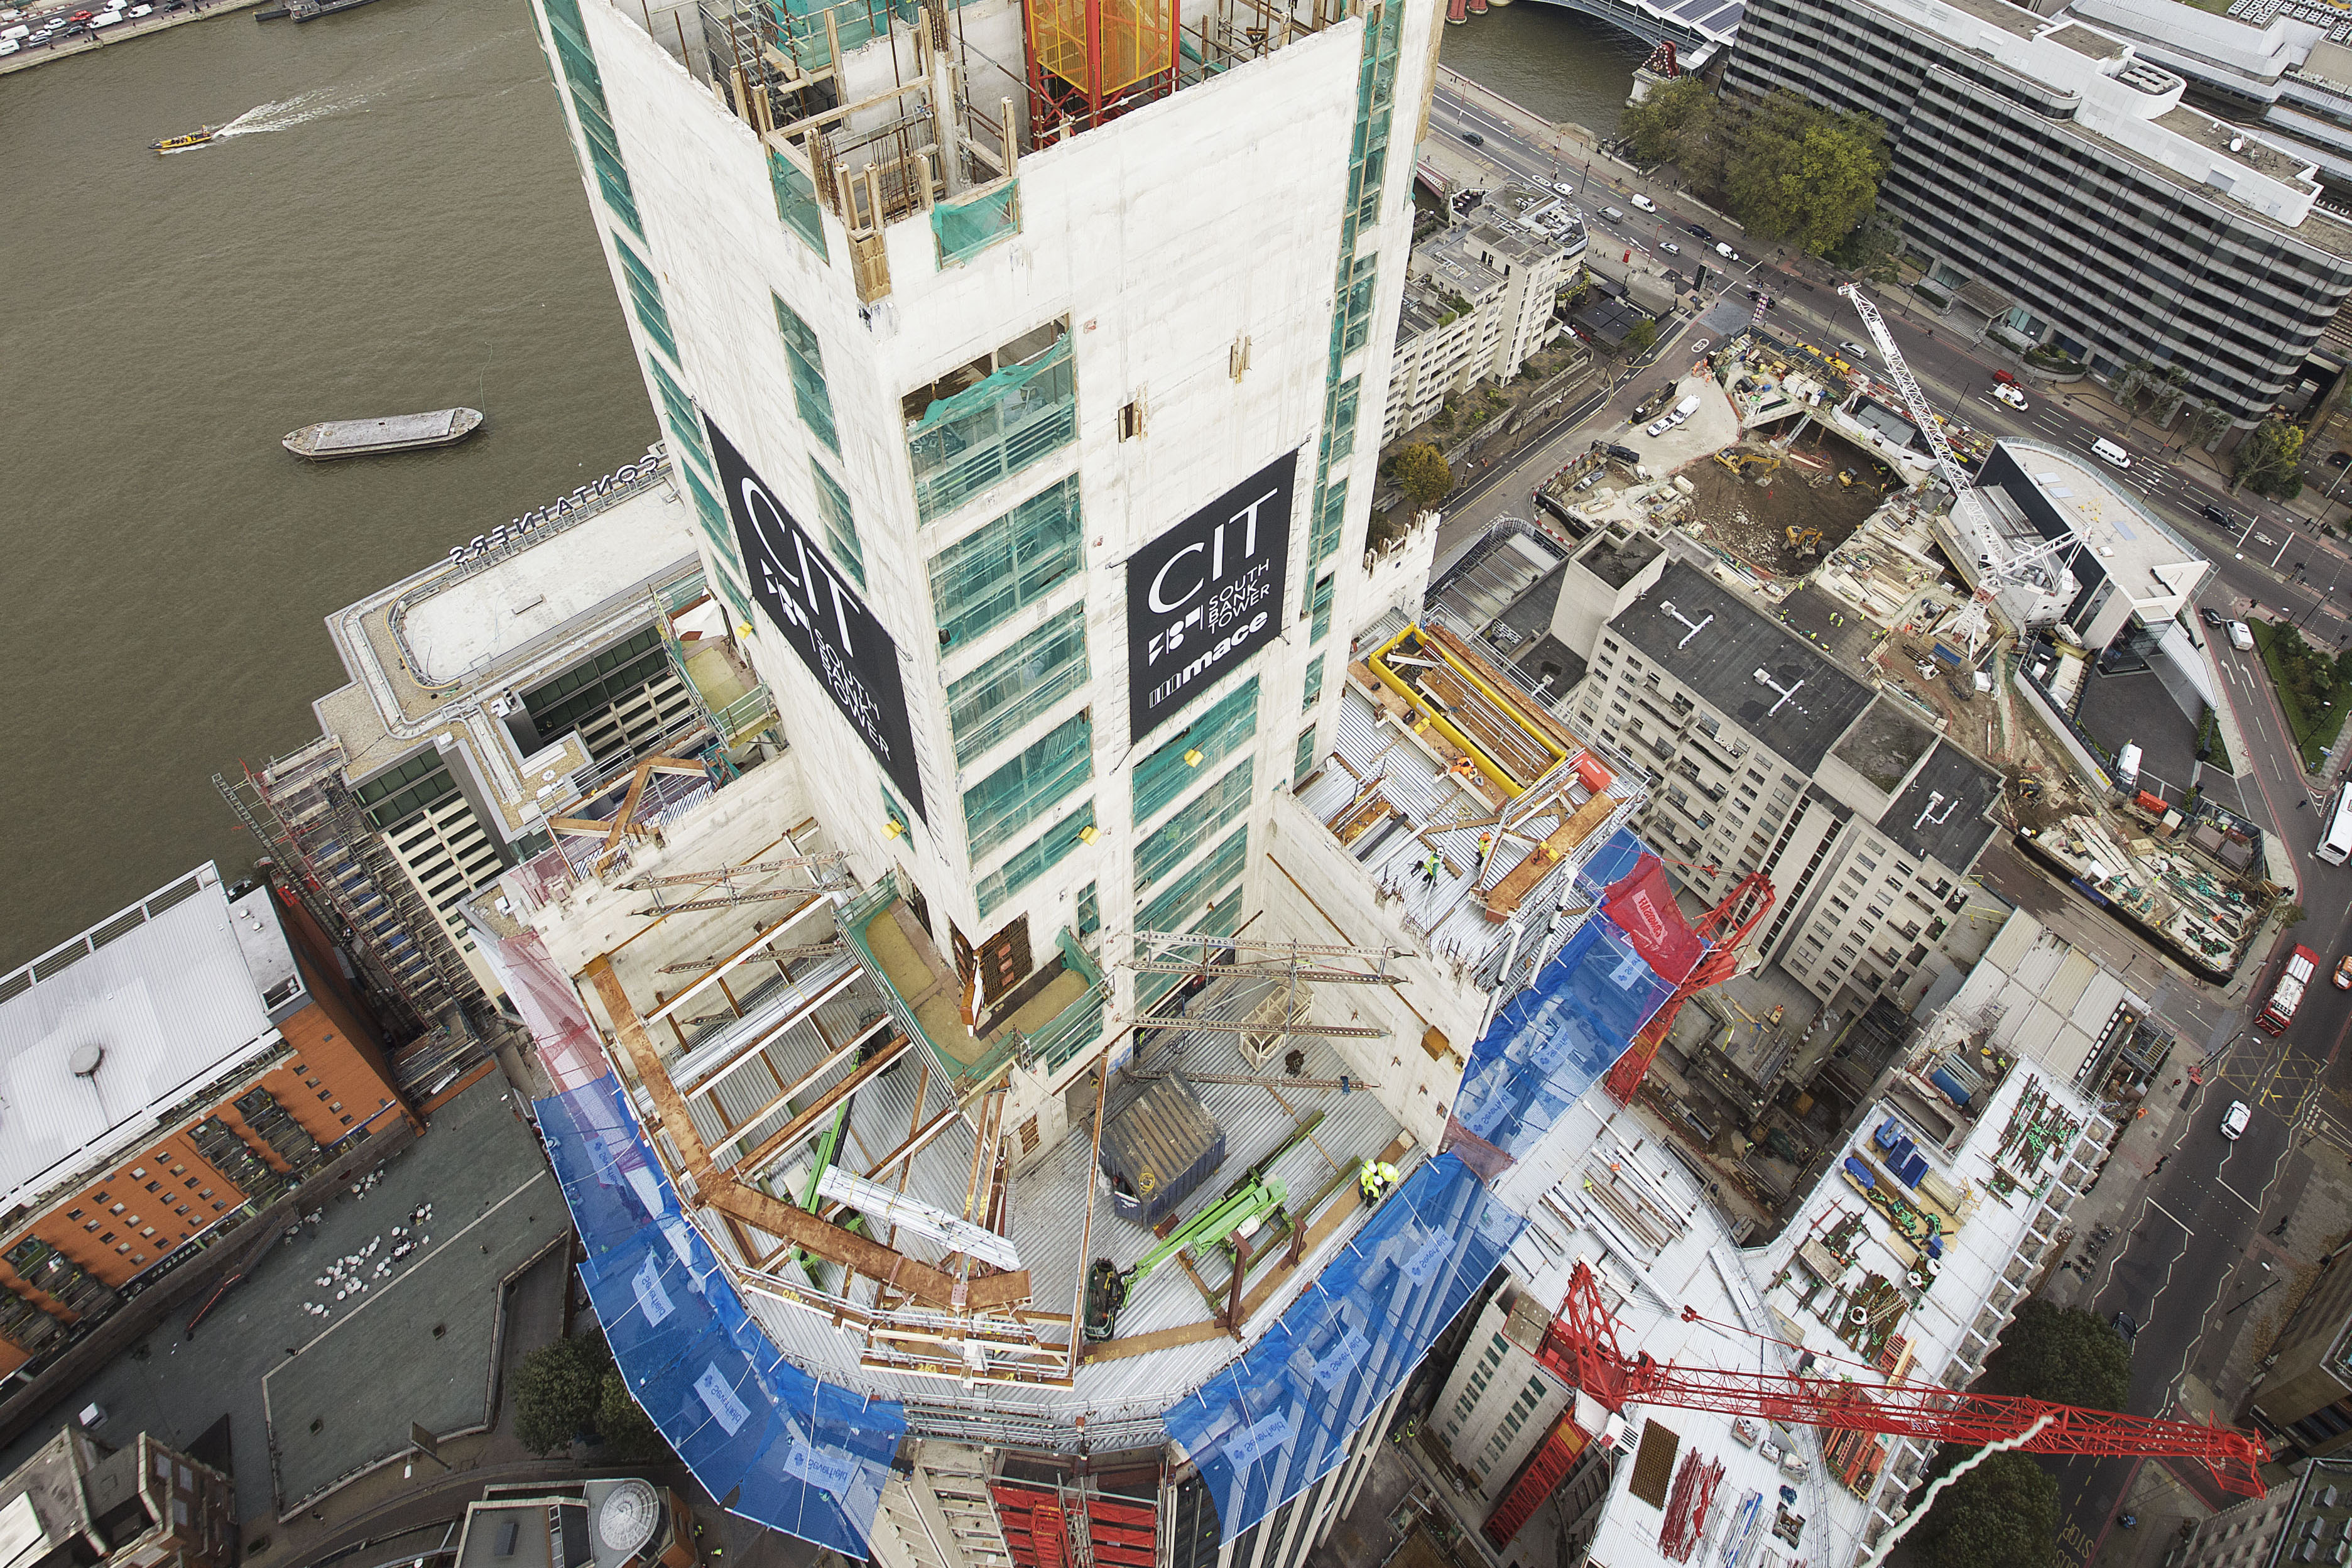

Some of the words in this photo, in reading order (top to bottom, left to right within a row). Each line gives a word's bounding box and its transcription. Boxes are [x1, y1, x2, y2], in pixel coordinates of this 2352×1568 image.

[741, 477, 861, 658] CIT
[1148, 487, 1278, 613] CIT
[1209, 558, 1270, 611] SOUTH
[1208, 584, 1270, 634] TOWER
[1209, 579, 1260, 624] BANK
[815, 628, 880, 721] SOUTH
[819, 646, 873, 724] BANK
[1182, 611, 1268, 684] mace
[822, 663, 891, 761] TOWER
[2062, 1523, 2094, 1559] STOP
